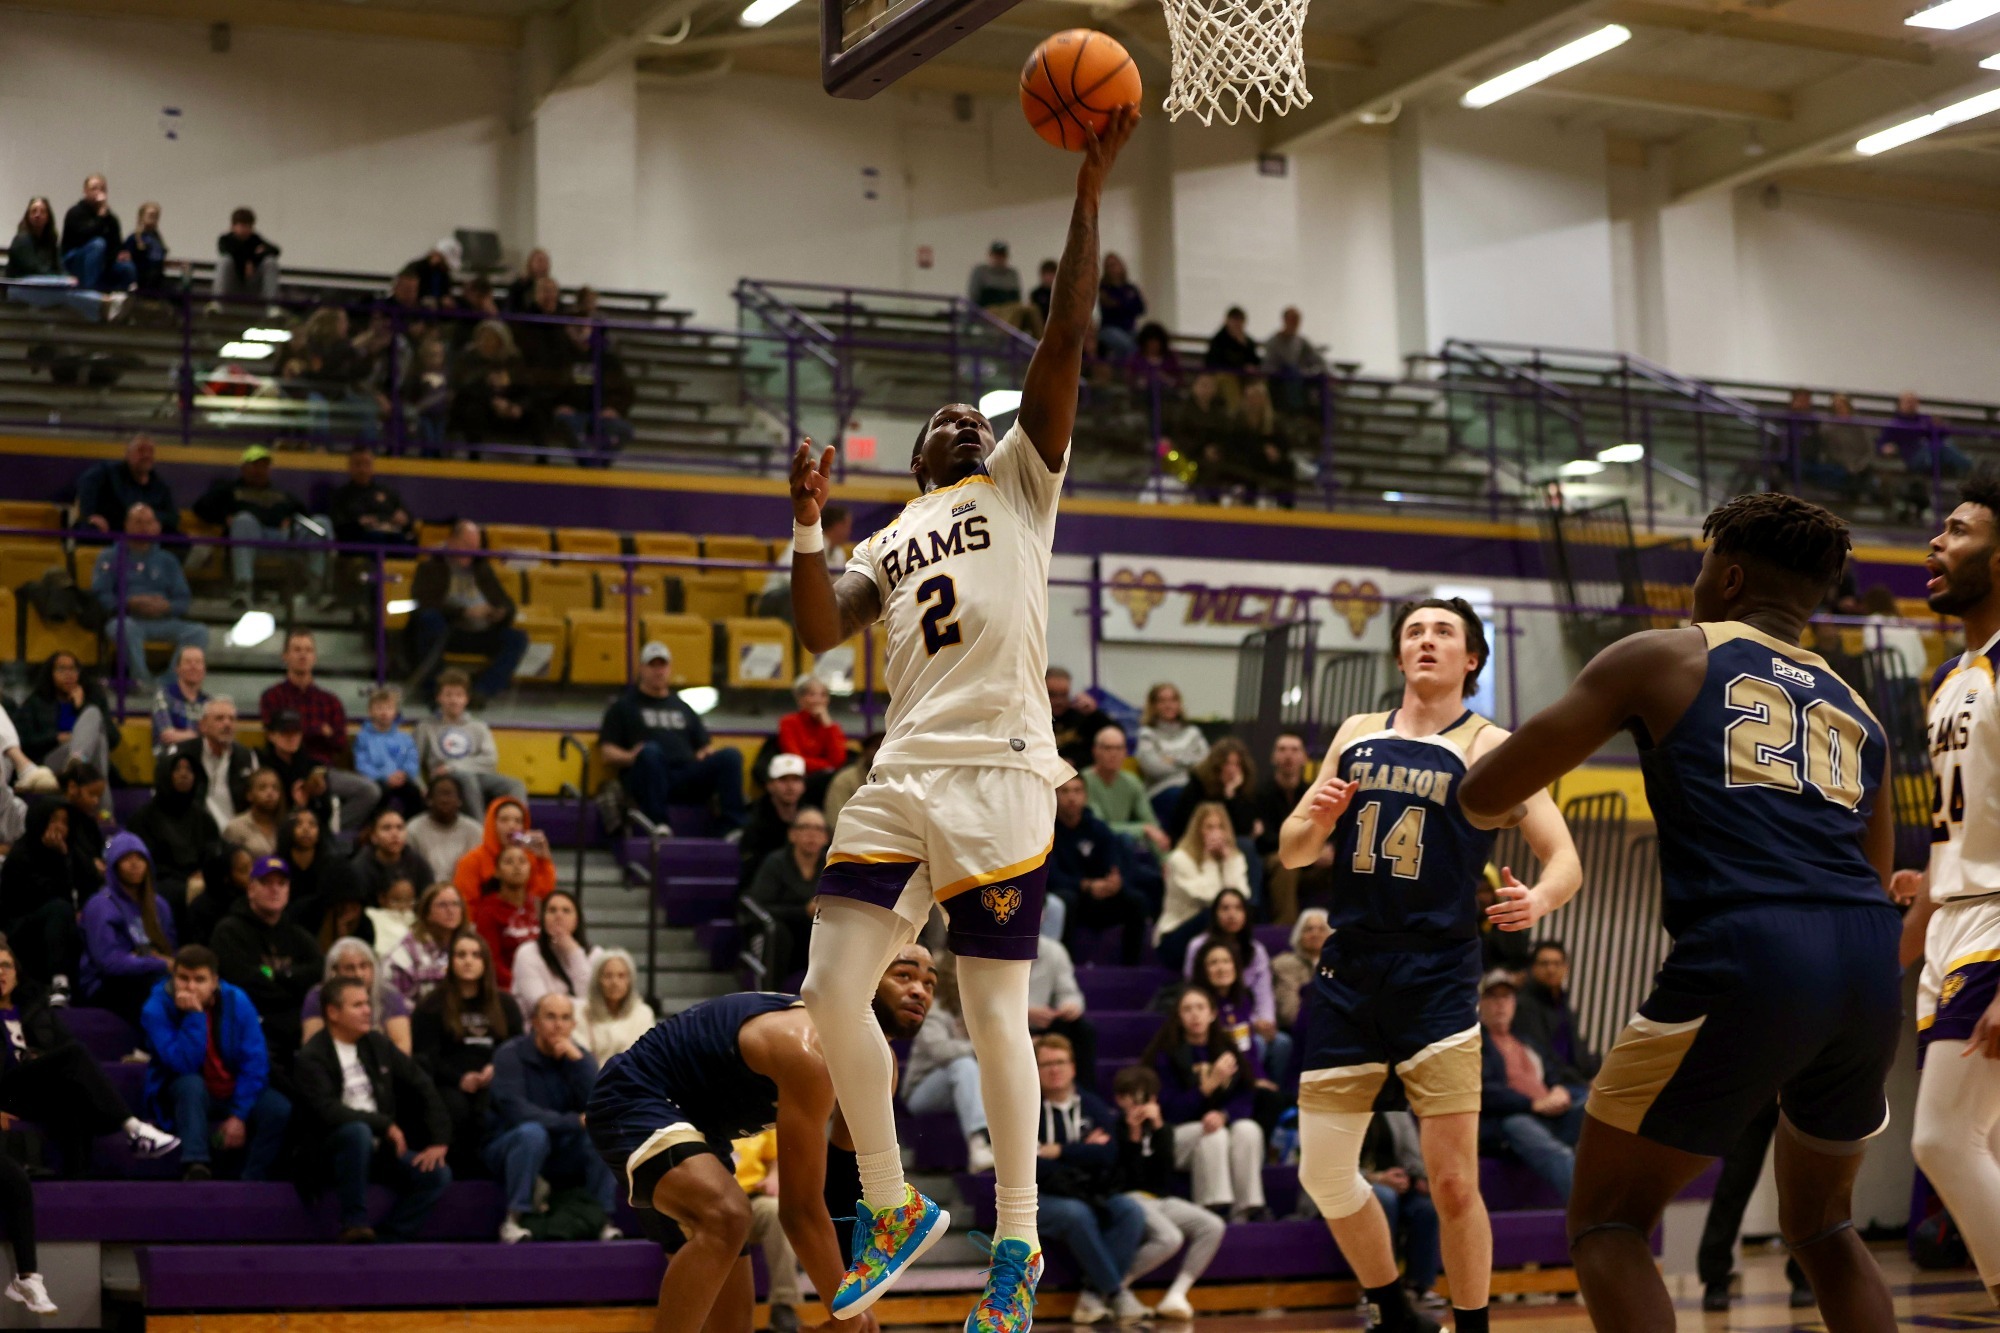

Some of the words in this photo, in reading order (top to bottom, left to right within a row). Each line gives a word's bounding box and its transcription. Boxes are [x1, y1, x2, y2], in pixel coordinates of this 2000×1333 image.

[951, 500, 976, 515] PSAC
[881, 515, 991, 592] RAMS
[915, 573, 963, 659] 2
[1182, 584, 1319, 630] WCU
[1773, 662, 1814, 684] PSAC
[1724, 673, 1868, 812] 20
[1349, 761, 1453, 807] CLARION
[1352, 801, 1426, 880] 14
